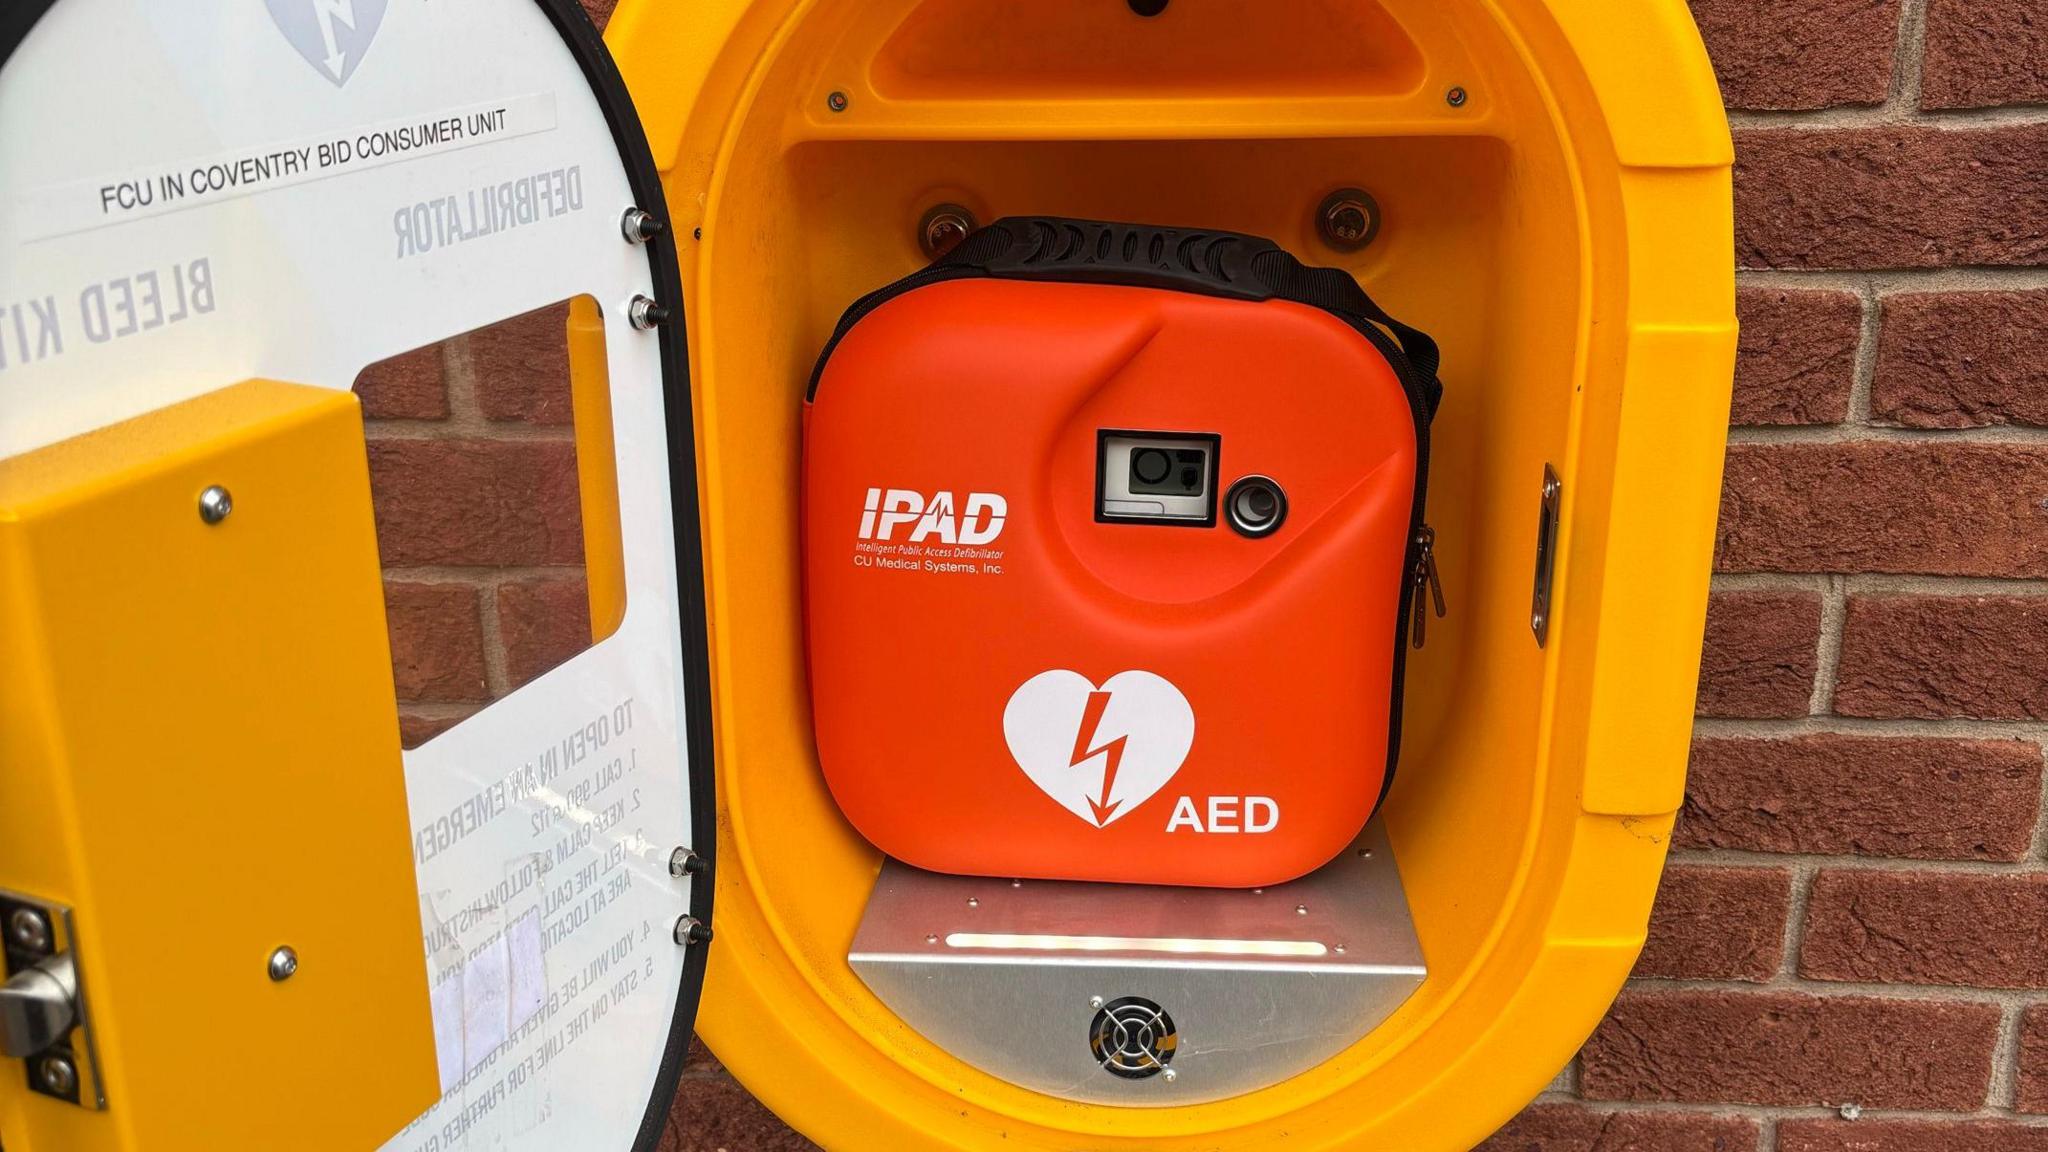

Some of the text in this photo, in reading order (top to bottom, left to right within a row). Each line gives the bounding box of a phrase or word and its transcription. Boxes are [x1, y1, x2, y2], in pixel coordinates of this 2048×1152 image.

[101, 108, 507, 213] FCU IN COVENTRY BID CONSUMER UNIT
[858, 487, 1008, 545] IPAD
[854, 555, 1005, 575] CU Medical Systems, Inc.
[855, 542, 1004, 559] Intelligent Public Access Defibrillator
[1165, 796, 1280, 833] AED
